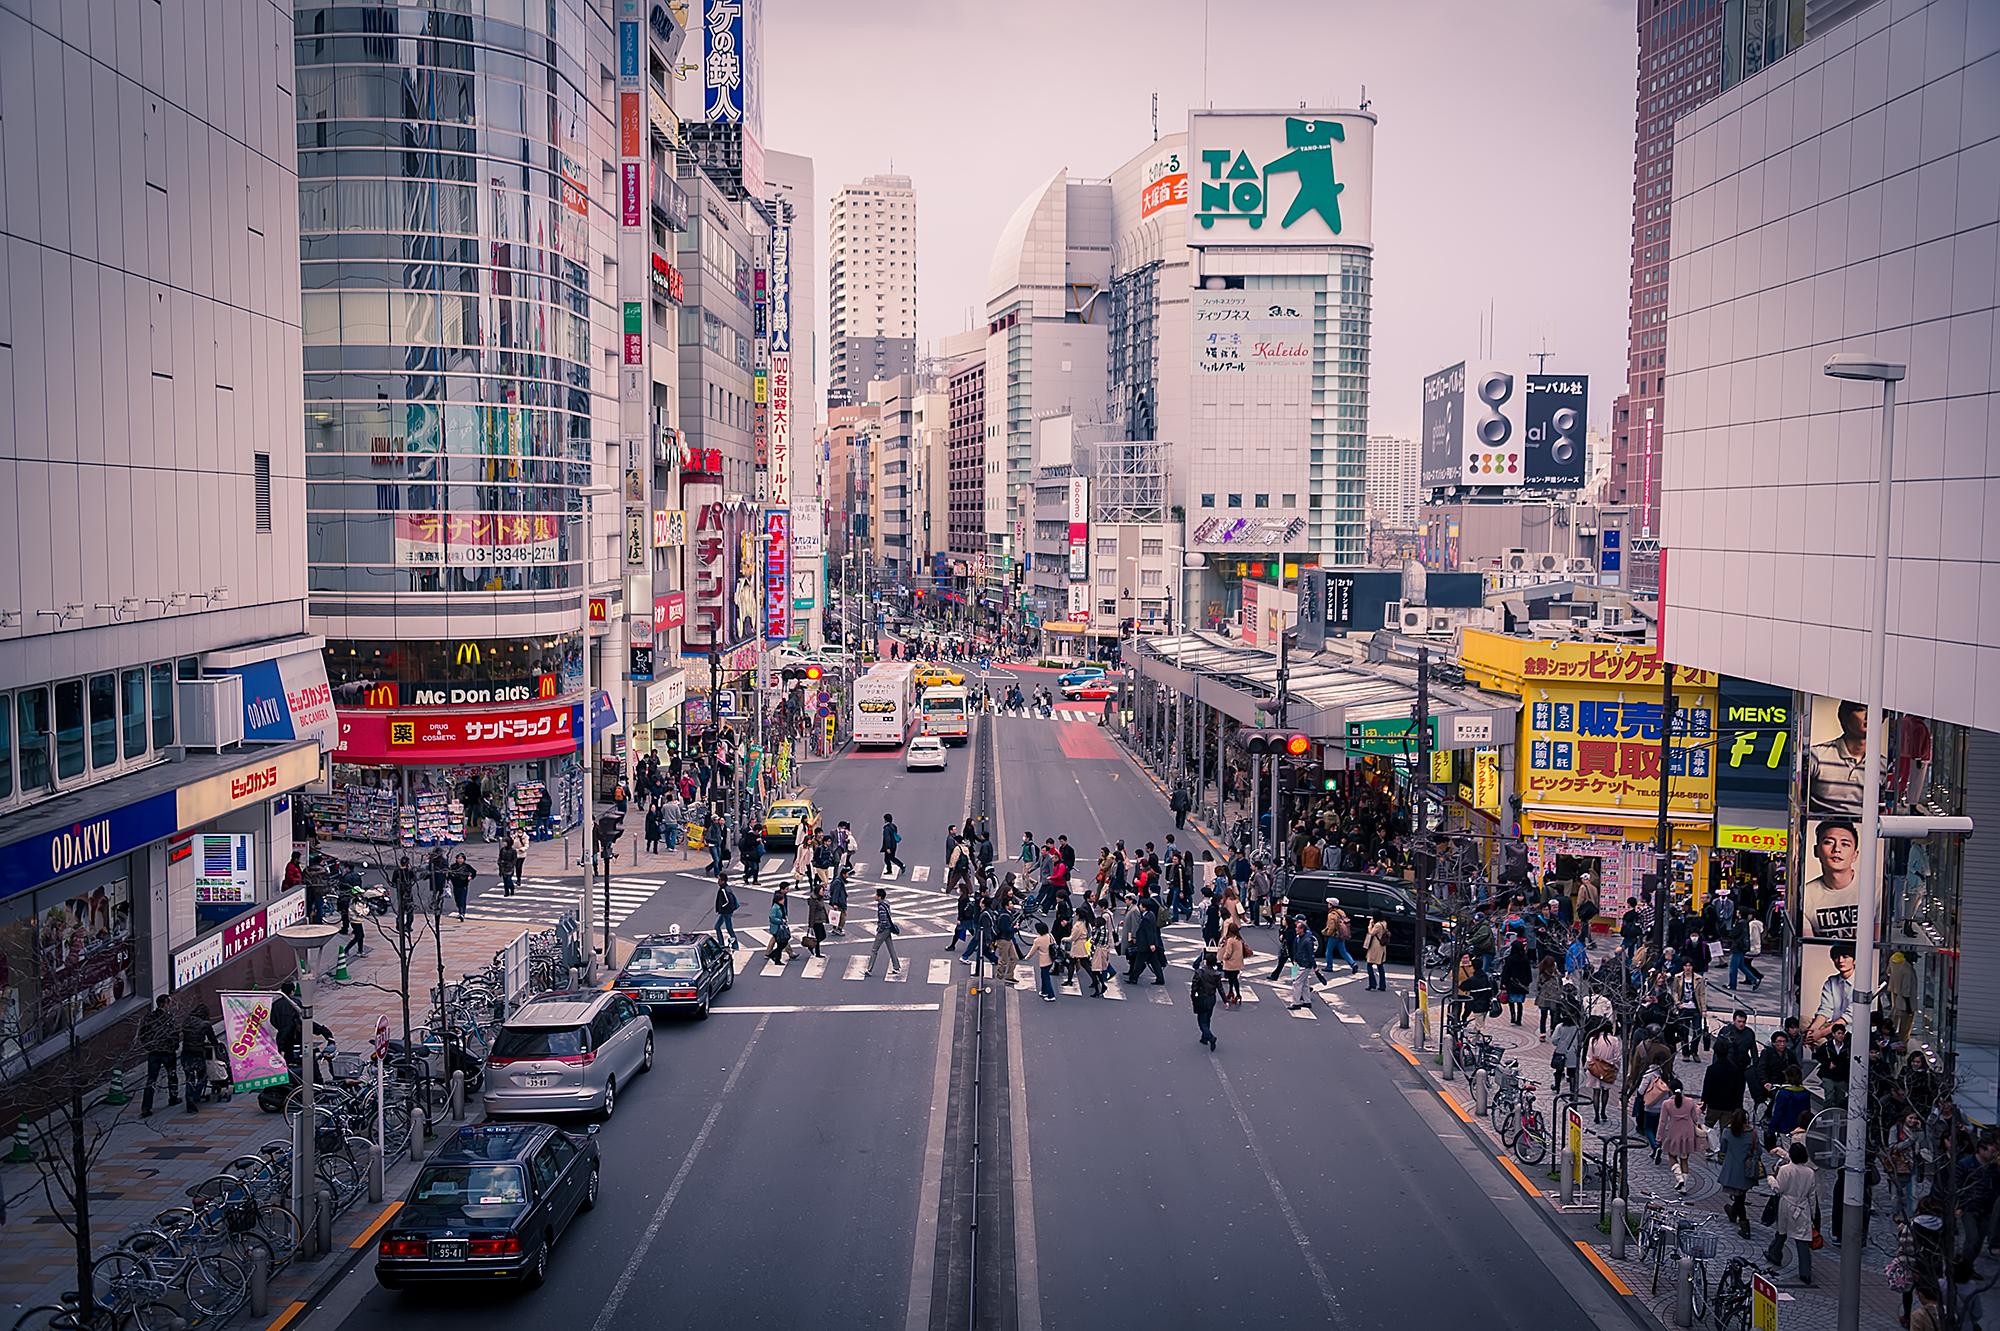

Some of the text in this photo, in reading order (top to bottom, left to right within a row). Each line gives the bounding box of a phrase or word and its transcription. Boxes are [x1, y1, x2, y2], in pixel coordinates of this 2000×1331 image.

[707, 0, 741, 120] ケの鉄人
[1202, 150, 1259, 179] TA
[1202, 181, 1262, 212] NO
[772, 229, 788, 350] カラオケの鉄人
[1197, 310, 1250, 321] ティップネス
[630, 335, 640, 364] 美容室
[1251, 342, 1309, 360] Kaleido
[773, 357, 787, 505] 100名収容大パーティールーム
[1525, 421, 1546, 441] al
[420, 517, 550, 541] テナント募集
[697, 501, 724, 632] パチンコ
[287, 683, 331, 713] ビックカメラ
[247, 697, 281, 730] ODAKYU
[310, 708, 329, 724] CAMERA
[429, 723, 449, 731] DRUG
[1536, 703, 1549, 729] 新幹線
[1577, 700, 1664, 739] 販売
[1729, 706, 1787, 723] MEN'S
[422, 734, 456, 742] COSMETIC
[465, 716, 551, 741] サンドラッグ
[1576, 741, 1662, 780] 買取
[231, 766, 277, 800] ビックカメラ
[1530, 777, 1635, 795] ビックチケット
[52, 819, 110, 873] ODAKYU
[1732, 833, 1787, 848] men's
[231, 1002, 269, 1058] Spring
